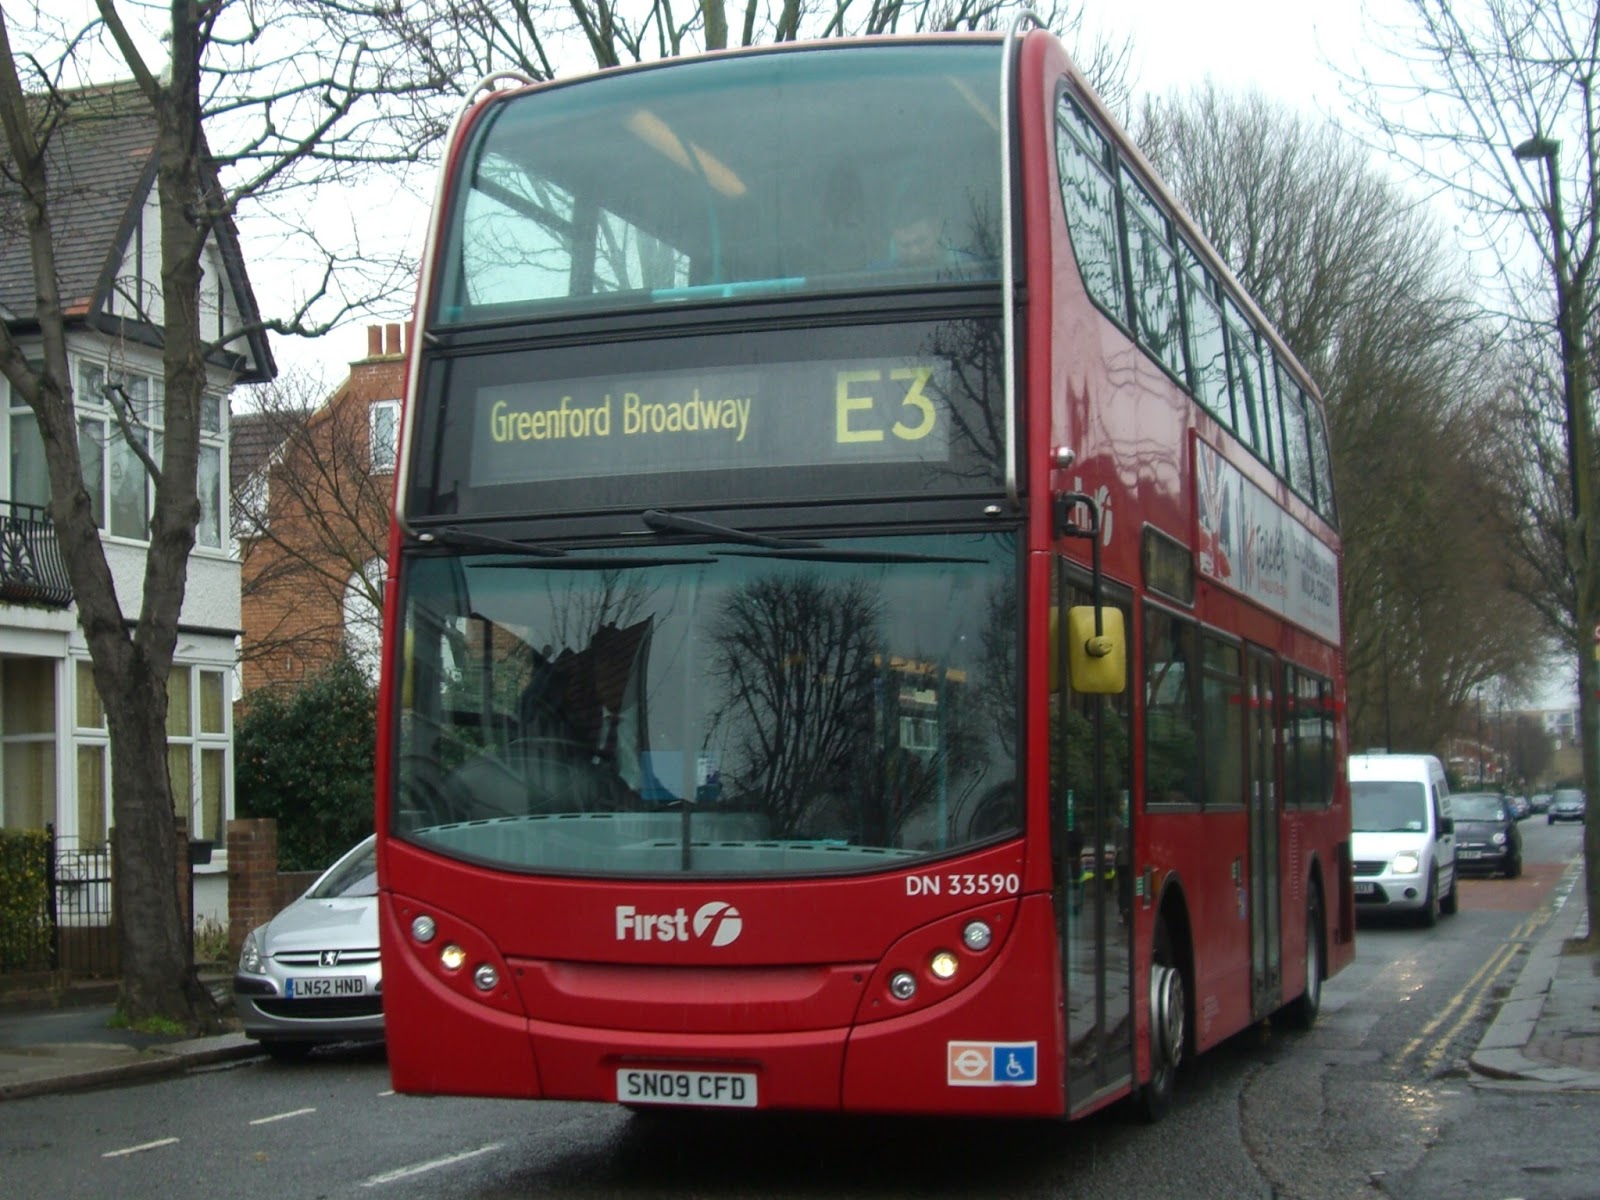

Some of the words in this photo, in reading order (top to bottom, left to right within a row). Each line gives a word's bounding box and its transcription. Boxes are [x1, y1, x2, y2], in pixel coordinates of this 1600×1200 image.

[491, 395, 610, 442] Greenford
[623, 389, 751, 442] Broadway
[836, 367, 936, 443] E3
[906, 876, 941, 896] DN
[949, 874, 1020, 896] 33590
[615, 905, 690, 942] First
[295, 980, 331, 996] LN52
[335, 978, 363, 994] HND
[627, 1072, 691, 1098] SN09
[698, 1076, 746, 1101] CFD
